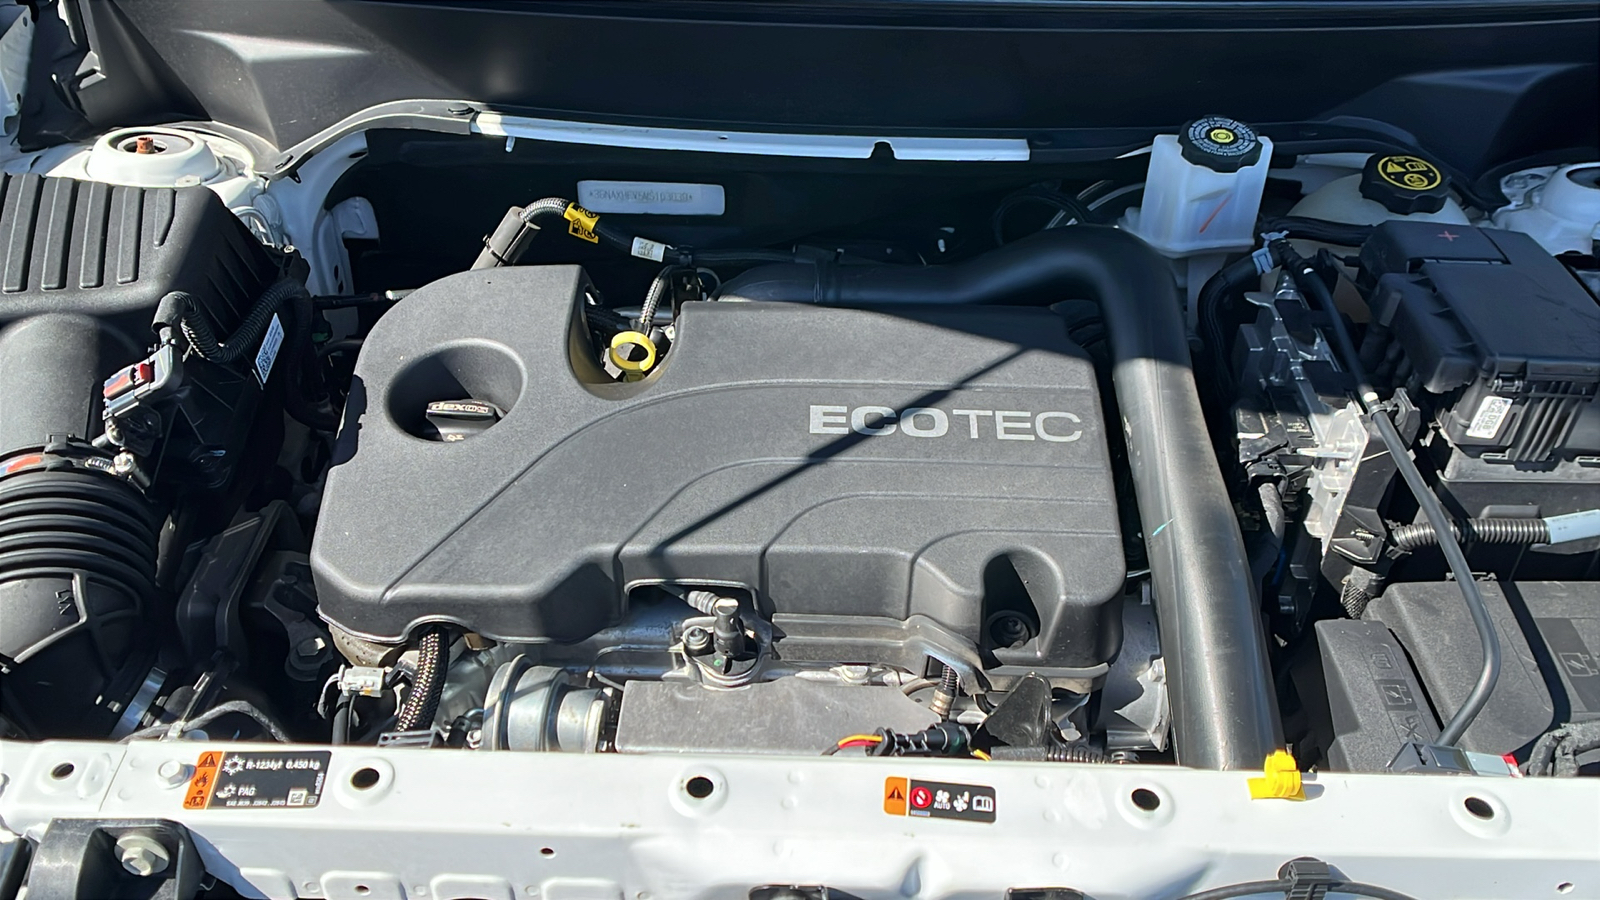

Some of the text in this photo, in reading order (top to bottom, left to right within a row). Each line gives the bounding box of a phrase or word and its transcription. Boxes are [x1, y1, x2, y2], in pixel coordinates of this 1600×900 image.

[431, 402, 489, 414] dexos
[809, 405, 1083, 443] ECOTEC
[245, 758, 321, 771] R-1234yf 0.450 kg
[238, 785, 257, 797] PAG
[933, 801, 951, 810] AUTO
